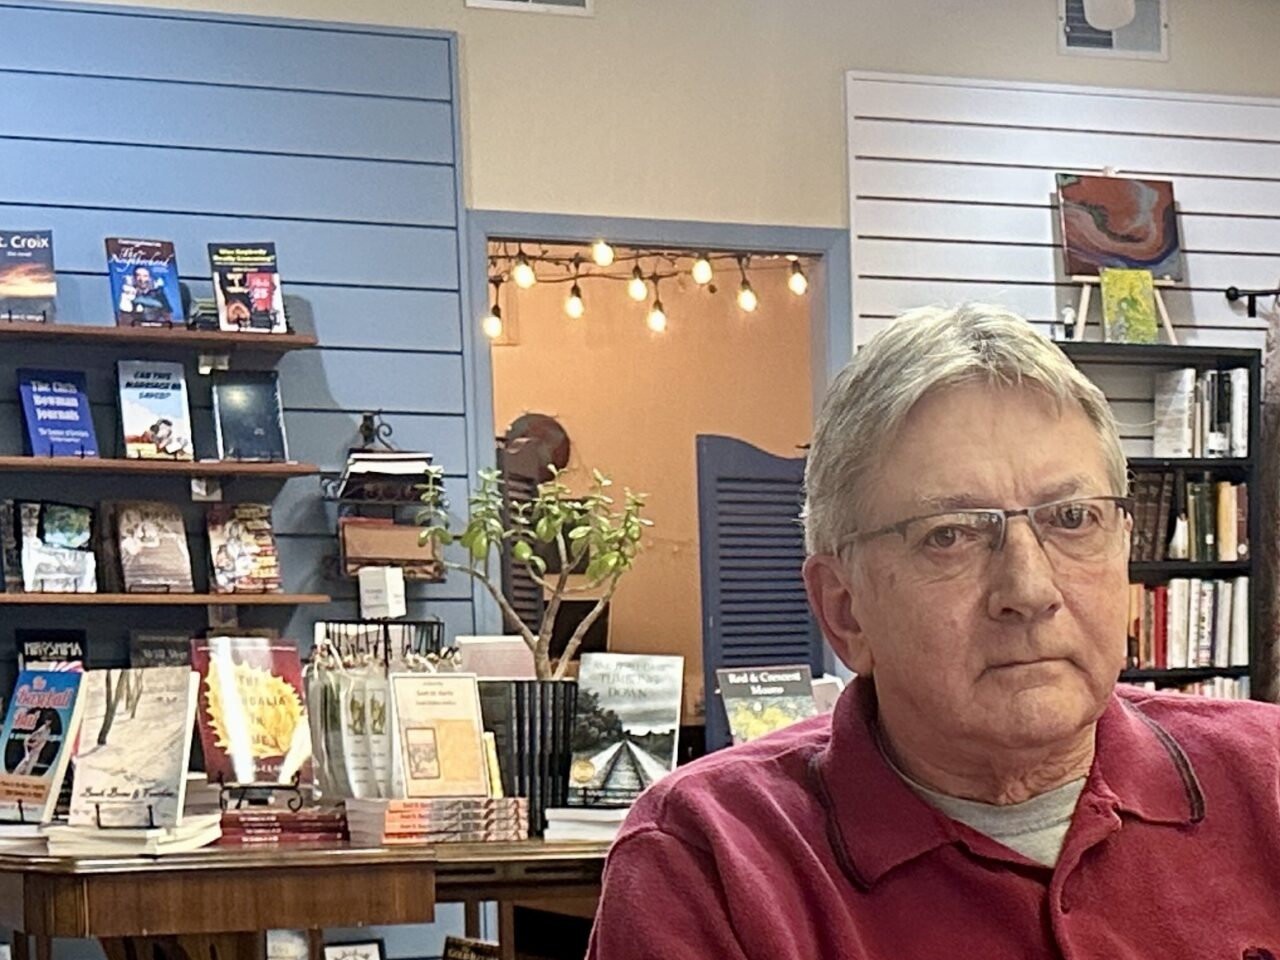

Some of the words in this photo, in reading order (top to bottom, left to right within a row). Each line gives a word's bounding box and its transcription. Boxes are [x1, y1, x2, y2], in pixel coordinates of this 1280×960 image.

[10, 234, 49, 249] Croix
[31, 380, 51, 392] The
[32, 394, 79, 408] Bowman
[35, 408, 80, 421] Journals
[24, 641, 83, 657] HIROSHIMA
[728, 673, 748, 684] Red
[750, 672, 759, 683] &
[759, 671, 801, 683] Crescent
[608, 687, 648, 698] DOWN
